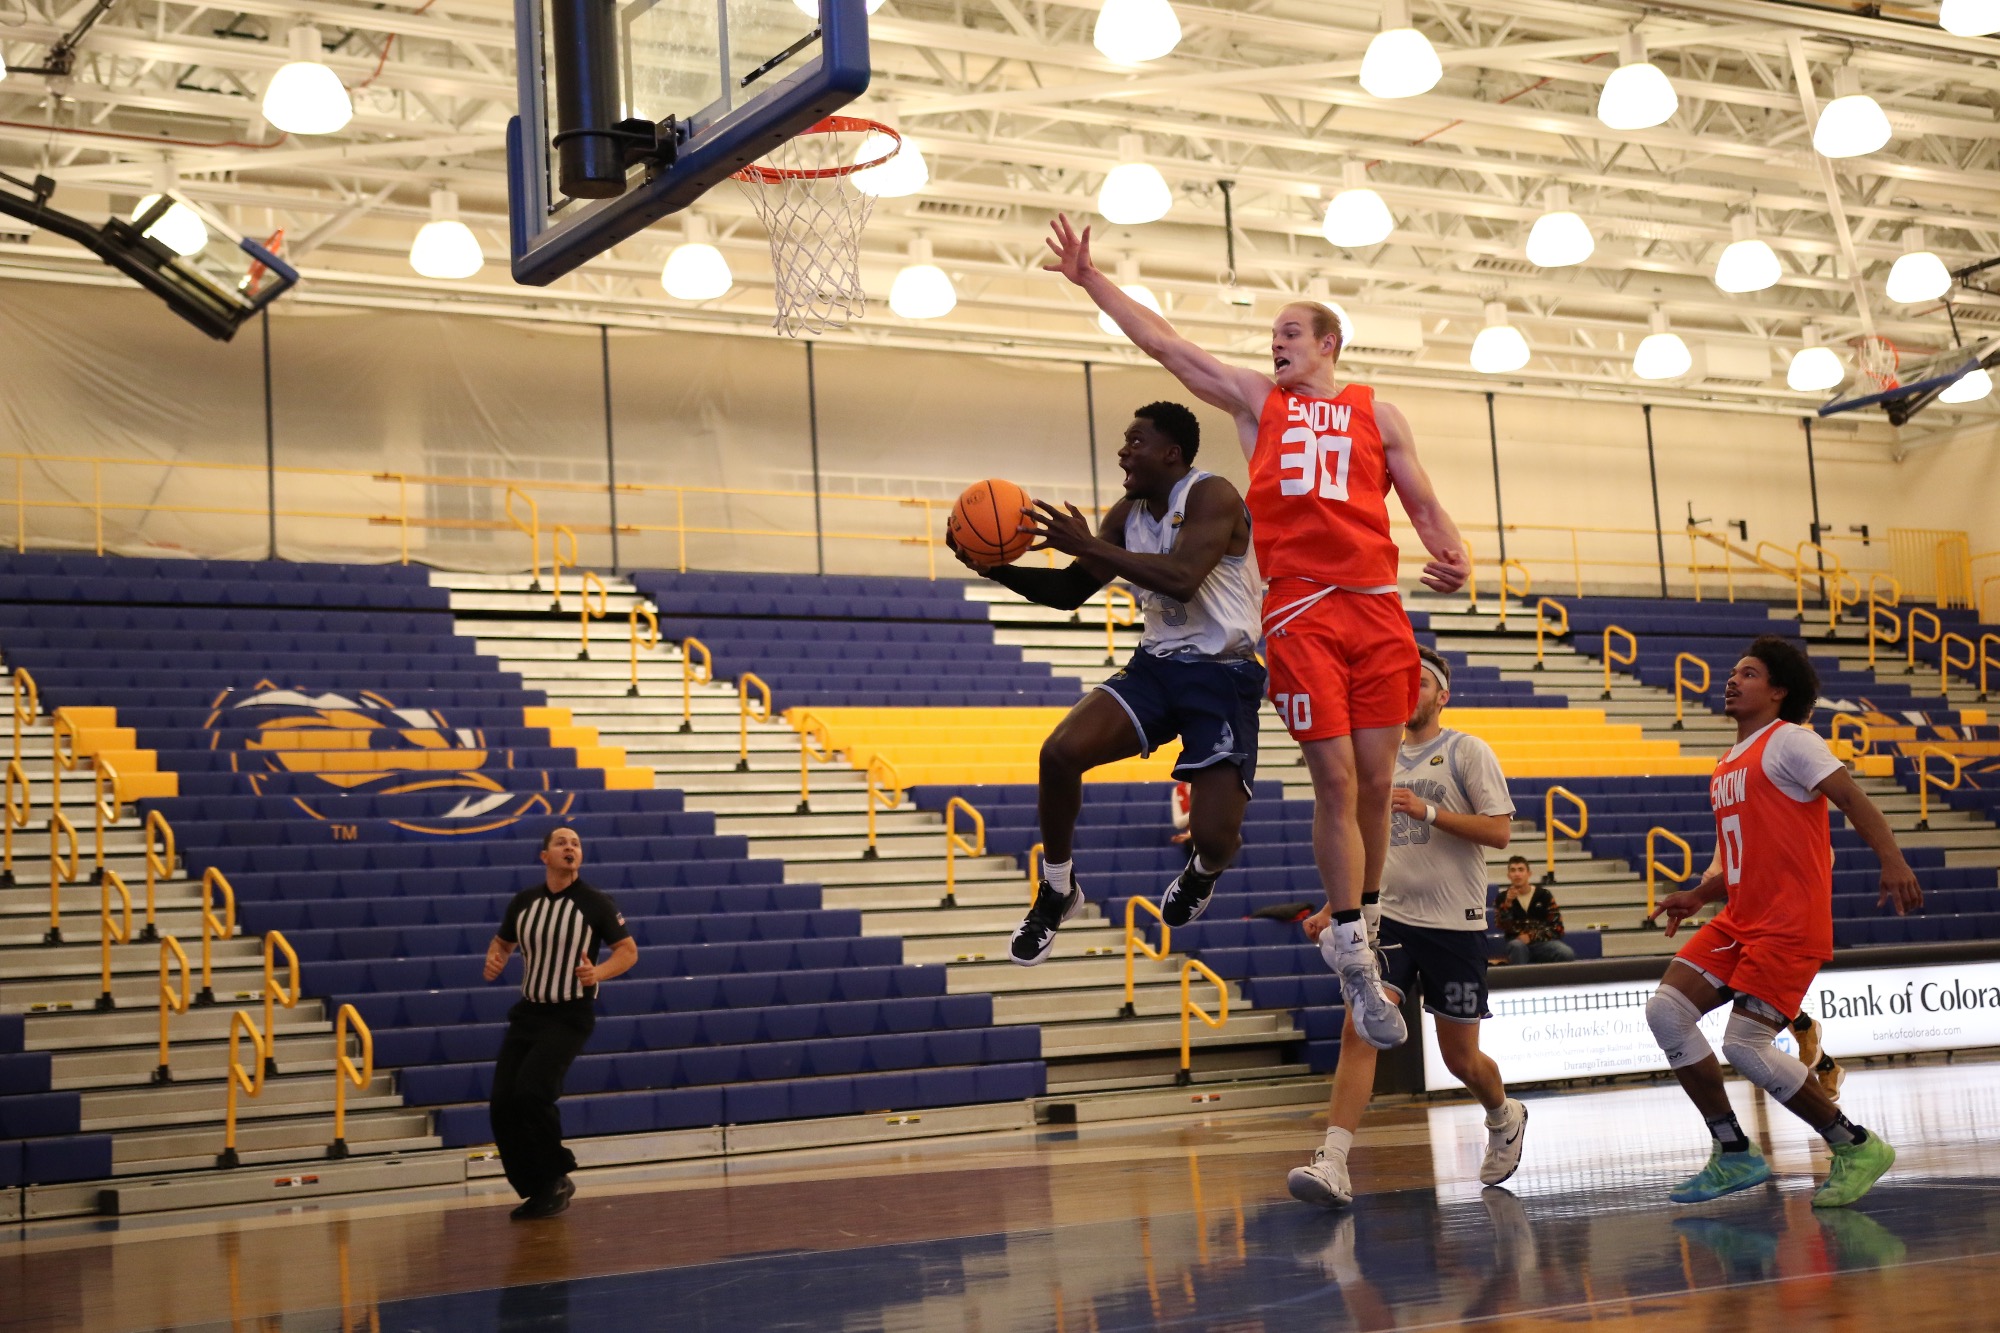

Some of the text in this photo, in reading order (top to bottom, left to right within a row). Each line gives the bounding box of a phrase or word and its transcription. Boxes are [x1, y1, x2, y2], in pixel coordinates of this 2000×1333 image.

[1288, 397, 1351, 432] SNOW
[1280, 427, 1352, 501] 30
[1275, 693, 1312, 730] 30
[1711, 767, 1748, 812] SNOW
[330, 824, 357, 840] TM
[1721, 814, 1743, 885] 0
[1445, 982, 1479, 1014] 25
[1820, 984, 1883, 1019] Bank
[1889, 981, 1913, 1015] of
[1521, 1026, 1541, 1043] Go
[1544, 1020, 1609, 1045] Skyhawks!
[1613, 1019, 1633, 1034] On
[1873, 1025, 1961, 1041] bankofcolorado.com
[1564, 1053, 1665, 1071] DurangoTrain.com 970-247
